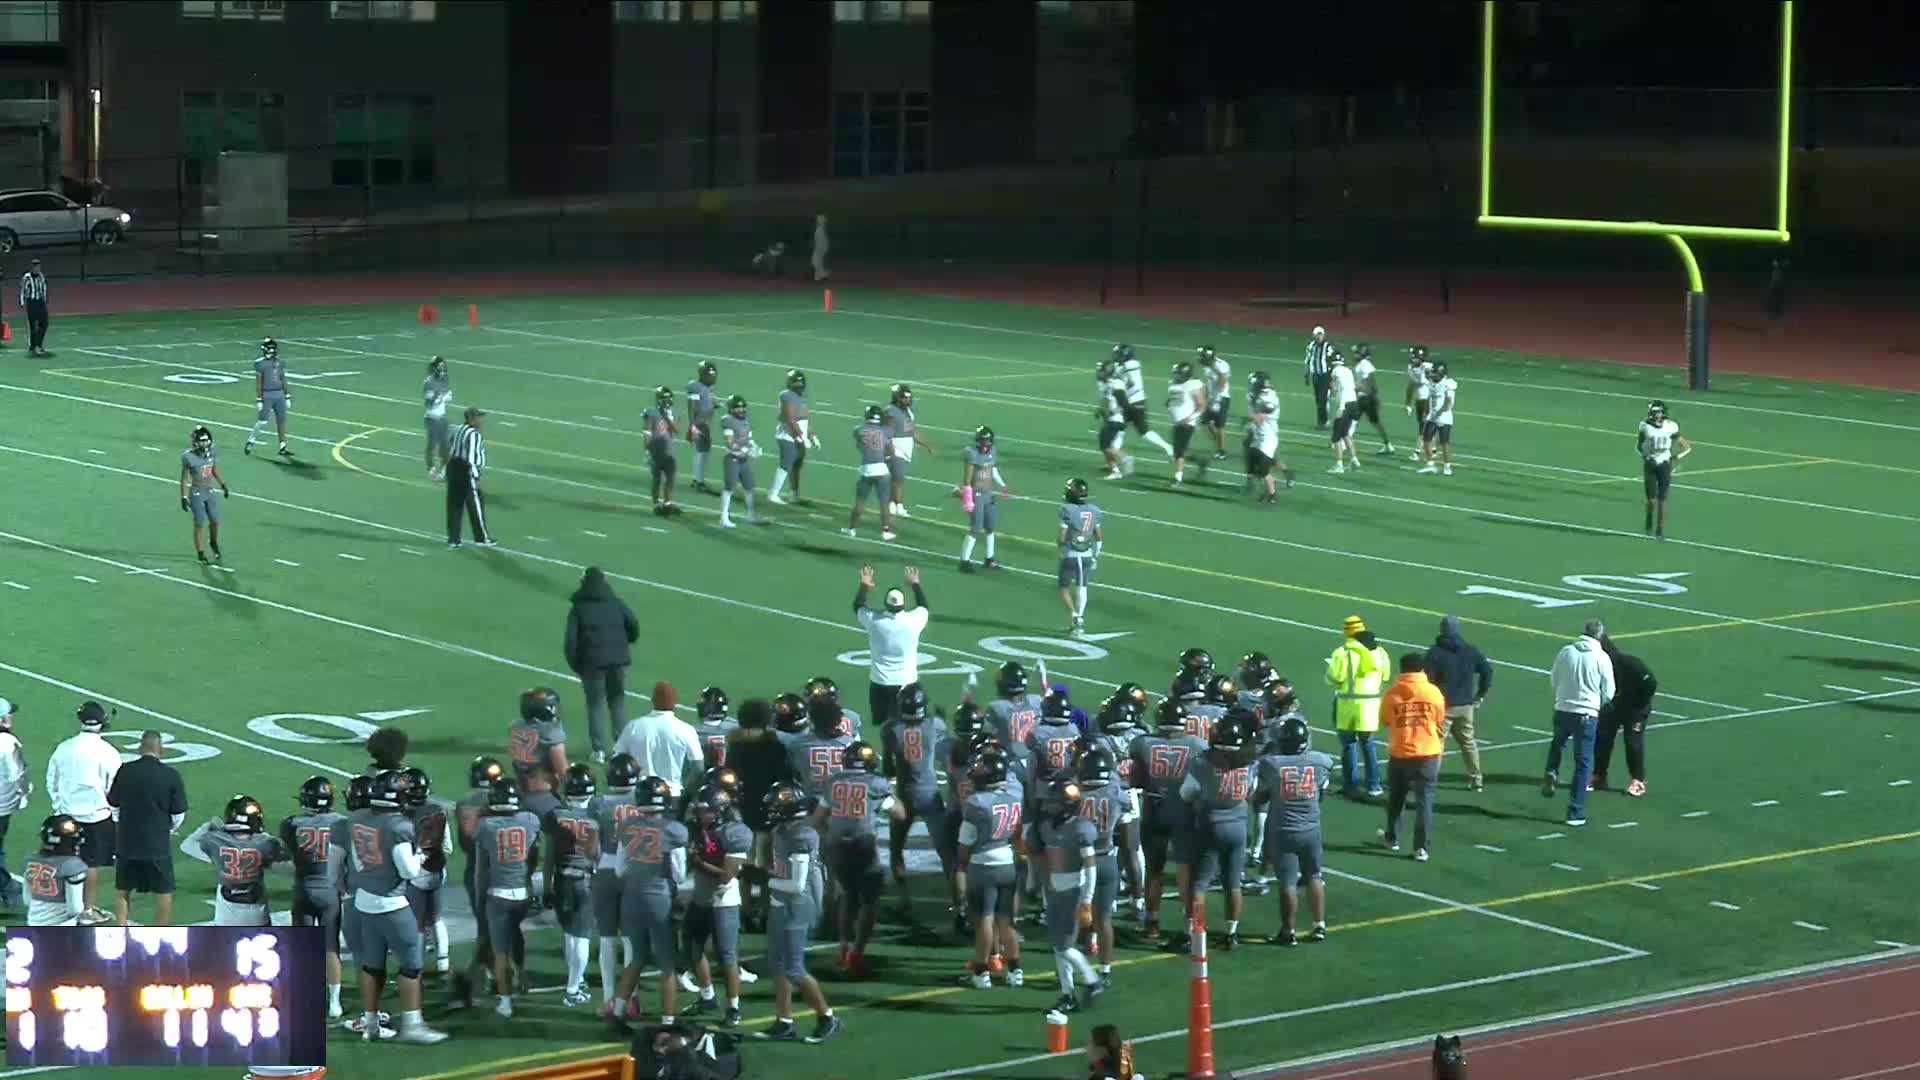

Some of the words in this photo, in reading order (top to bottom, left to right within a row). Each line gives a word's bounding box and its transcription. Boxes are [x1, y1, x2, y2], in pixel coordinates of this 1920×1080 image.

[904, 728, 922, 761] 8
[832, 781, 867, 819] 98
[1279, 765, 1315, 801] 64
[497, 826, 527, 863] 19
[219, 847, 262, 881] 32
